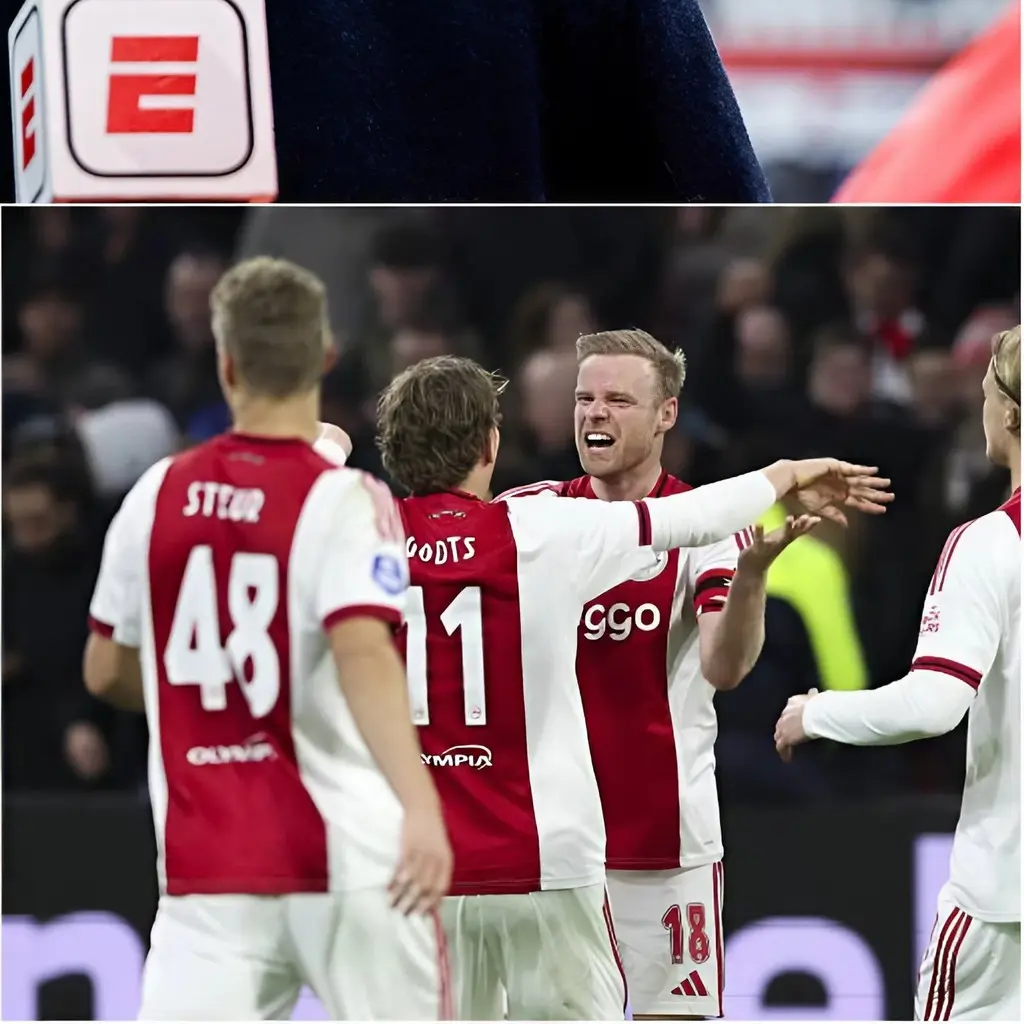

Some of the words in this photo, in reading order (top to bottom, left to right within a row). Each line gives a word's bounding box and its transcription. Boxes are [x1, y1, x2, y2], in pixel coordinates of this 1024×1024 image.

[106, 35, 199, 134] E
[163, 544, 281, 719] 48
[401, 586, 487, 726] 11
[420, 749, 493, 769] YMPIA
[661, 902, 711, 965] 18
